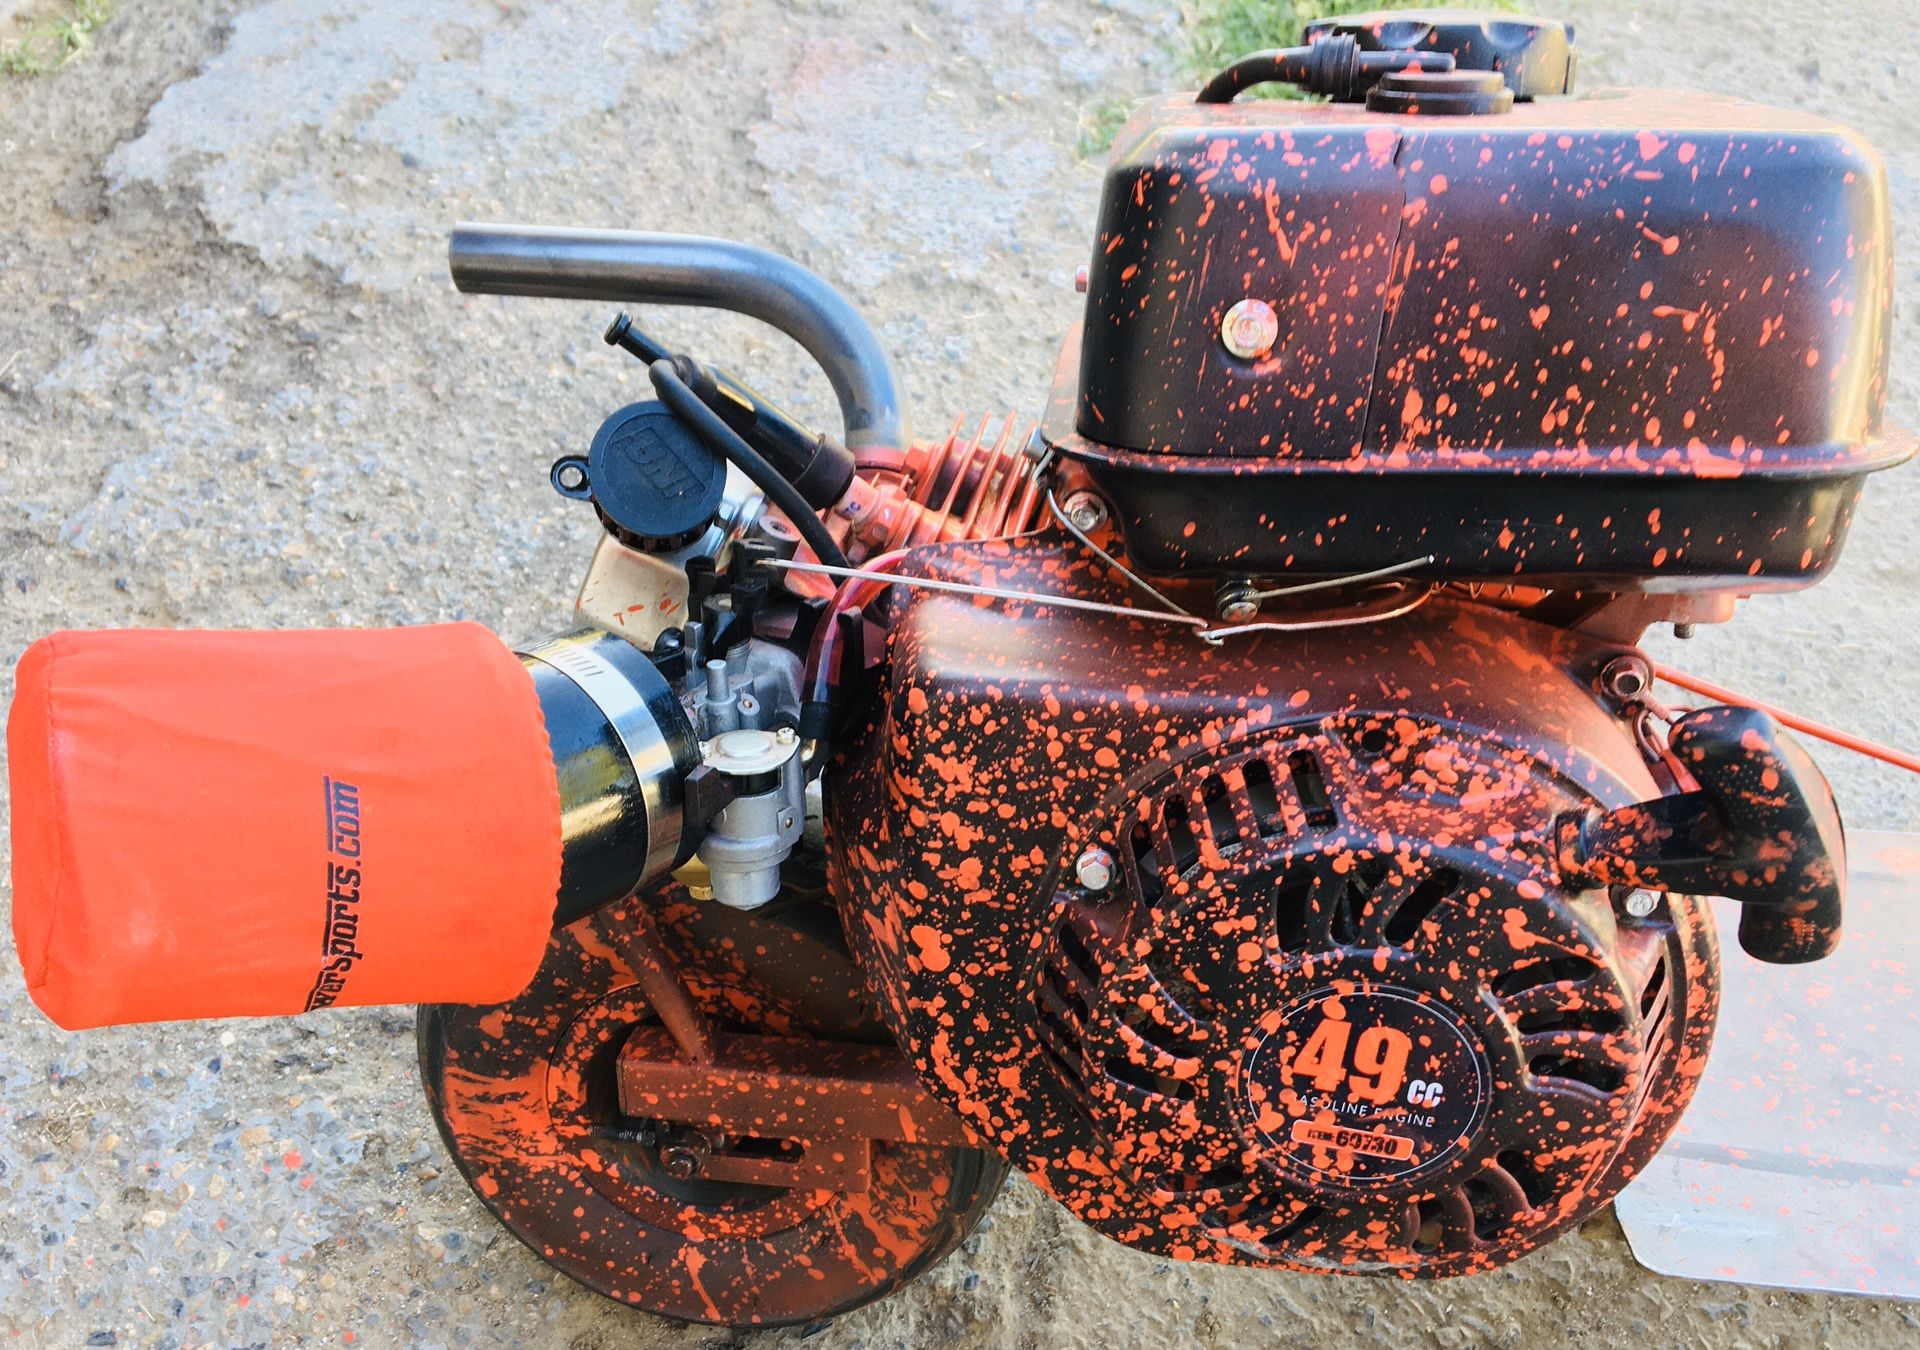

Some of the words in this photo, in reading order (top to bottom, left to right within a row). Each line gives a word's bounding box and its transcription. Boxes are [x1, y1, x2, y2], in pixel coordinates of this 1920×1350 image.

[1293, 1019, 1413, 1105] 49
[1294, 1093, 1368, 1118] ASOLINE
[1374, 1106, 1434, 1128] ENGINE
